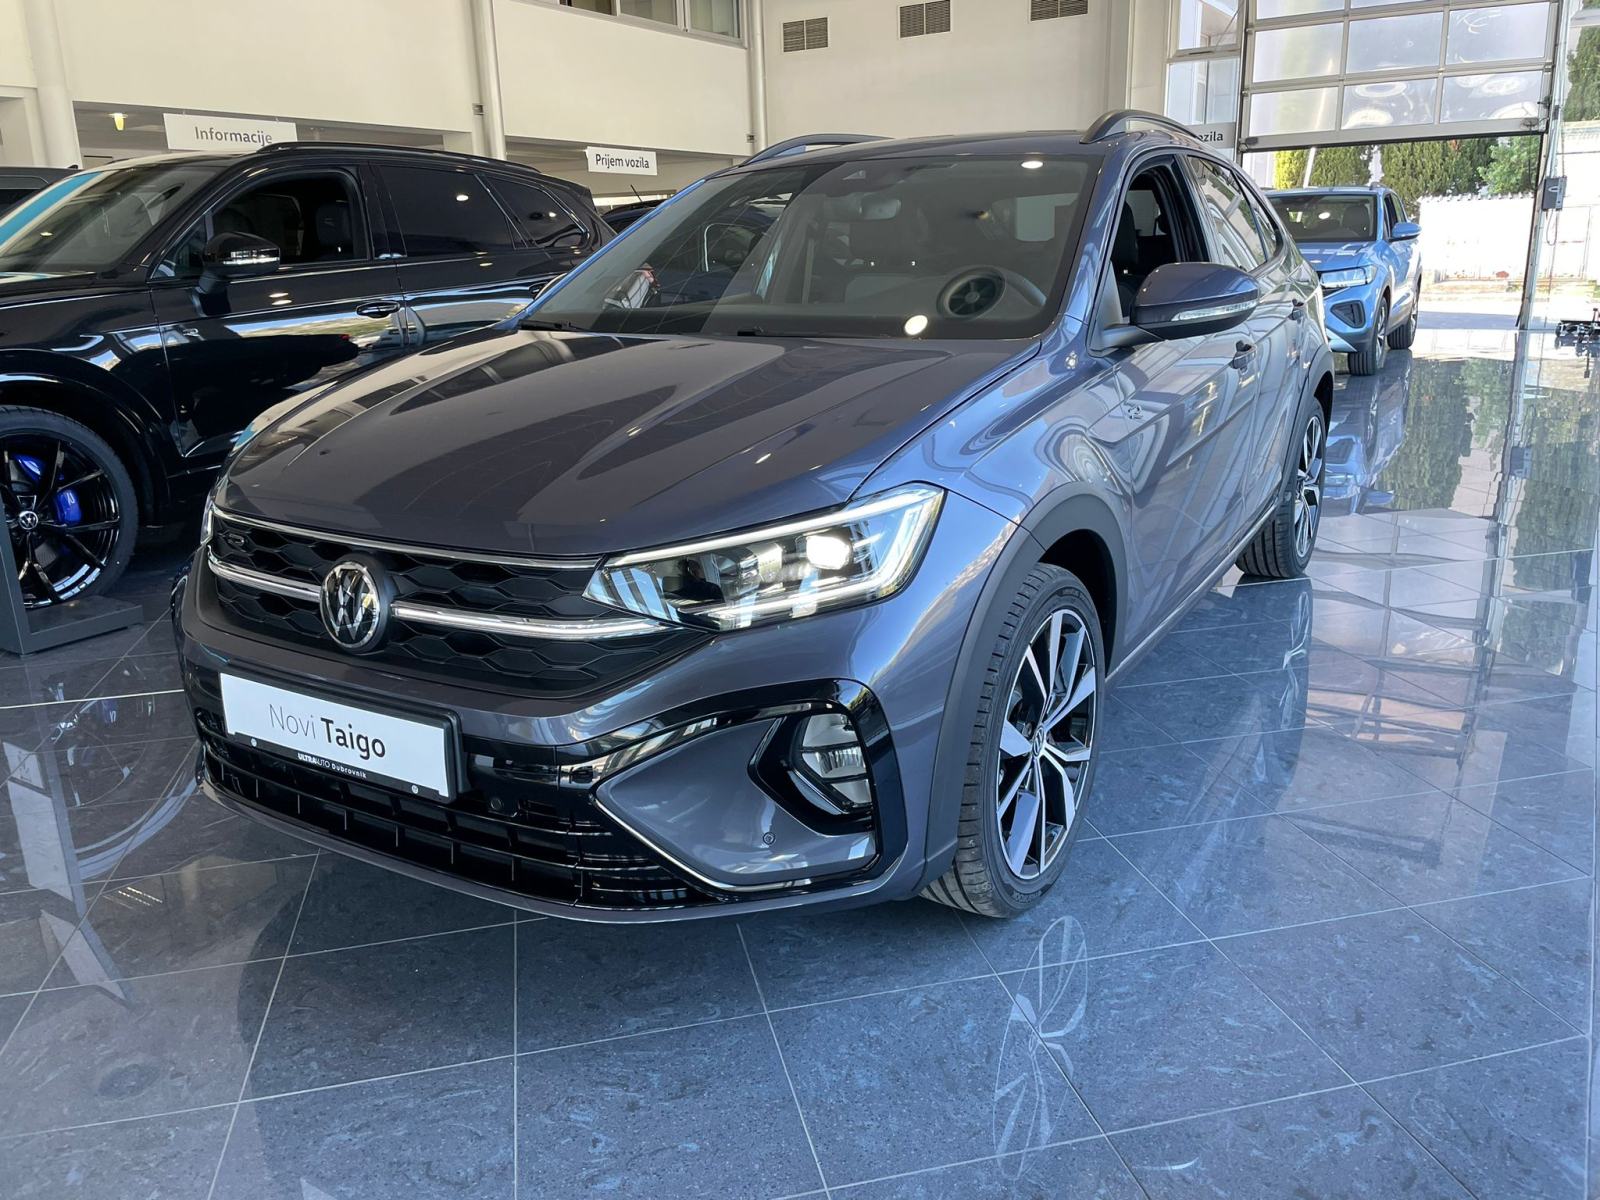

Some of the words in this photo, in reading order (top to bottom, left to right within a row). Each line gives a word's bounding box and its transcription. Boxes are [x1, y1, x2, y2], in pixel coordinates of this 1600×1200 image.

[194, 126, 273, 146] Informacije
[595, 153, 624, 169] Prijem
[624, 157, 650, 169] vozila
[269, 703, 317, 740] Novi
[320, 717, 386, 761] Taigo
